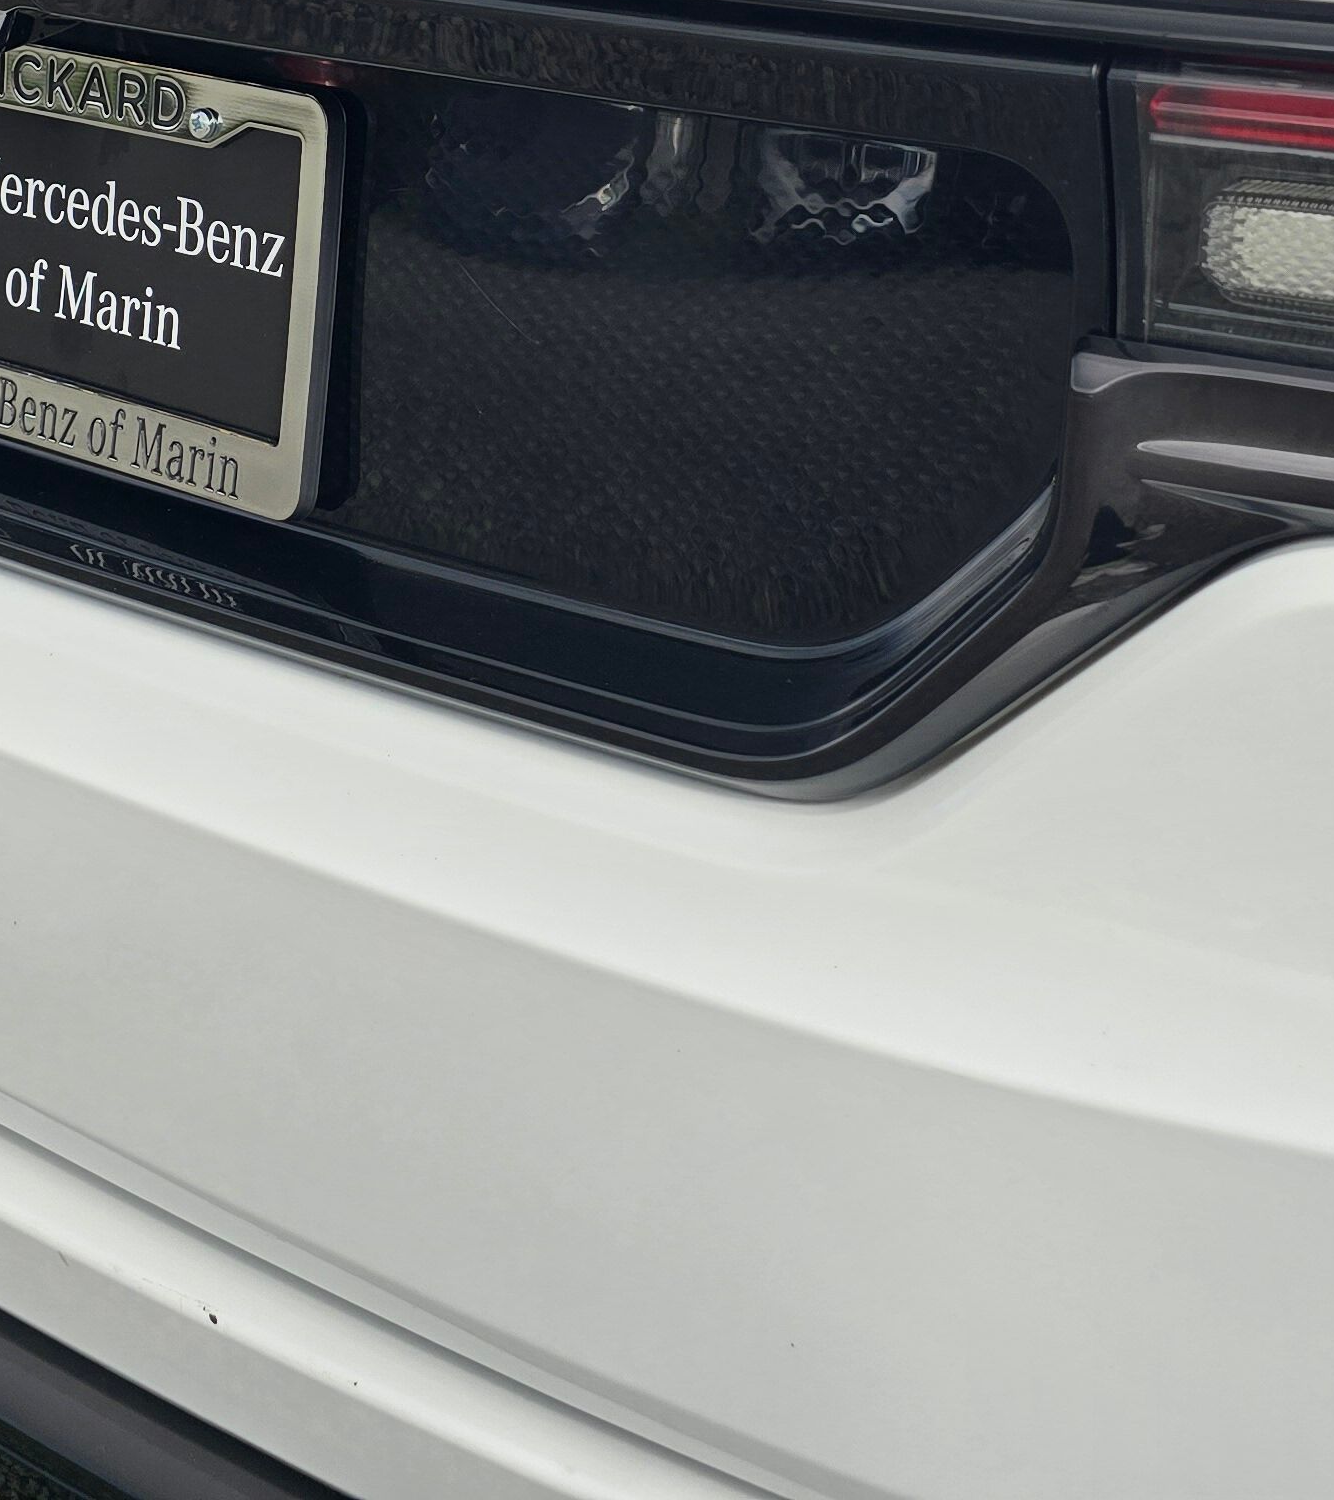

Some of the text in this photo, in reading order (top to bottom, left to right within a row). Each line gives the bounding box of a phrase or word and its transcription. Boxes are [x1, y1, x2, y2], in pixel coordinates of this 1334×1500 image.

[5, 258, 182, 351] of Marin
[87, 408, 127, 463] of
[130, 416, 242, 502] Marin
